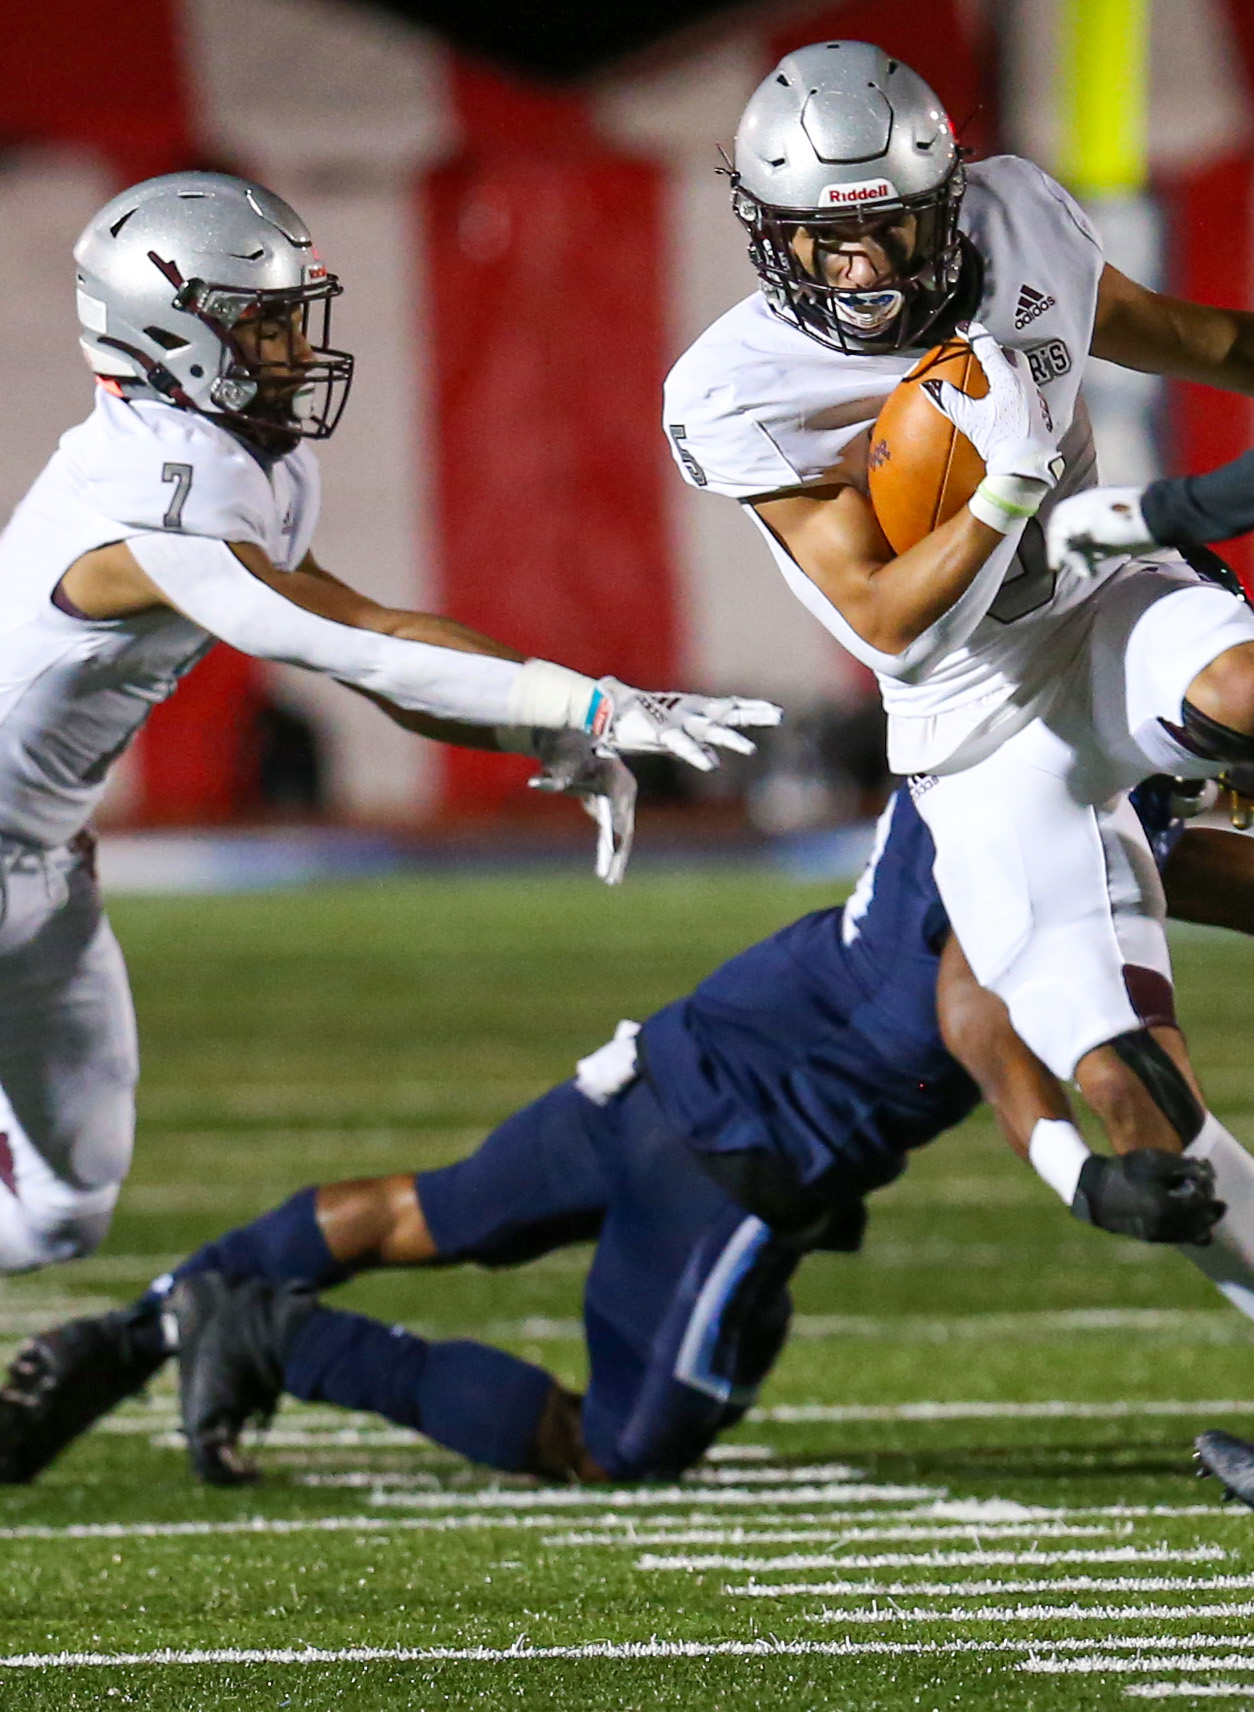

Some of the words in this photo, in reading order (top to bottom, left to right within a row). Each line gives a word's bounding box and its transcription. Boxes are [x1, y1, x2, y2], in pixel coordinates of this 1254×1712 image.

[829, 184, 888, 203] Riddell
[1014, 295, 1056, 331] adidas
[161, 462, 193, 528] 7
